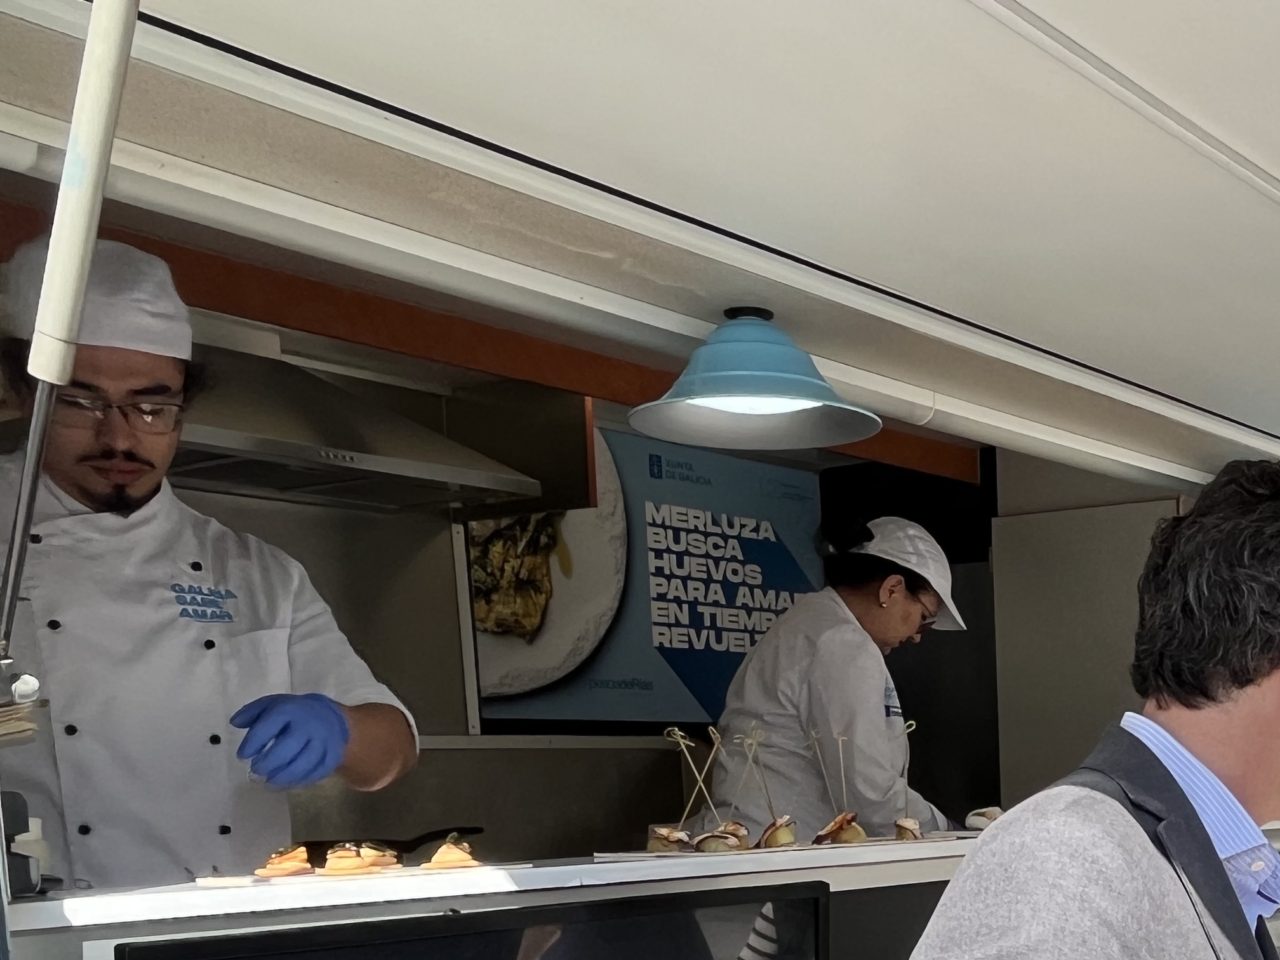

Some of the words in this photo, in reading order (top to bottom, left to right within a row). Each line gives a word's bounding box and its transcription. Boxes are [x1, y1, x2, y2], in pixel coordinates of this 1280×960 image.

[646, 501, 777, 542] MERLUZA
[647, 527, 744, 560] BUSCA
[648, 551, 762, 585] HUEVOS
[650, 576, 726, 604] PARA
[735, 586, 797, 610] AMA
[651, 600, 690, 625] EN
